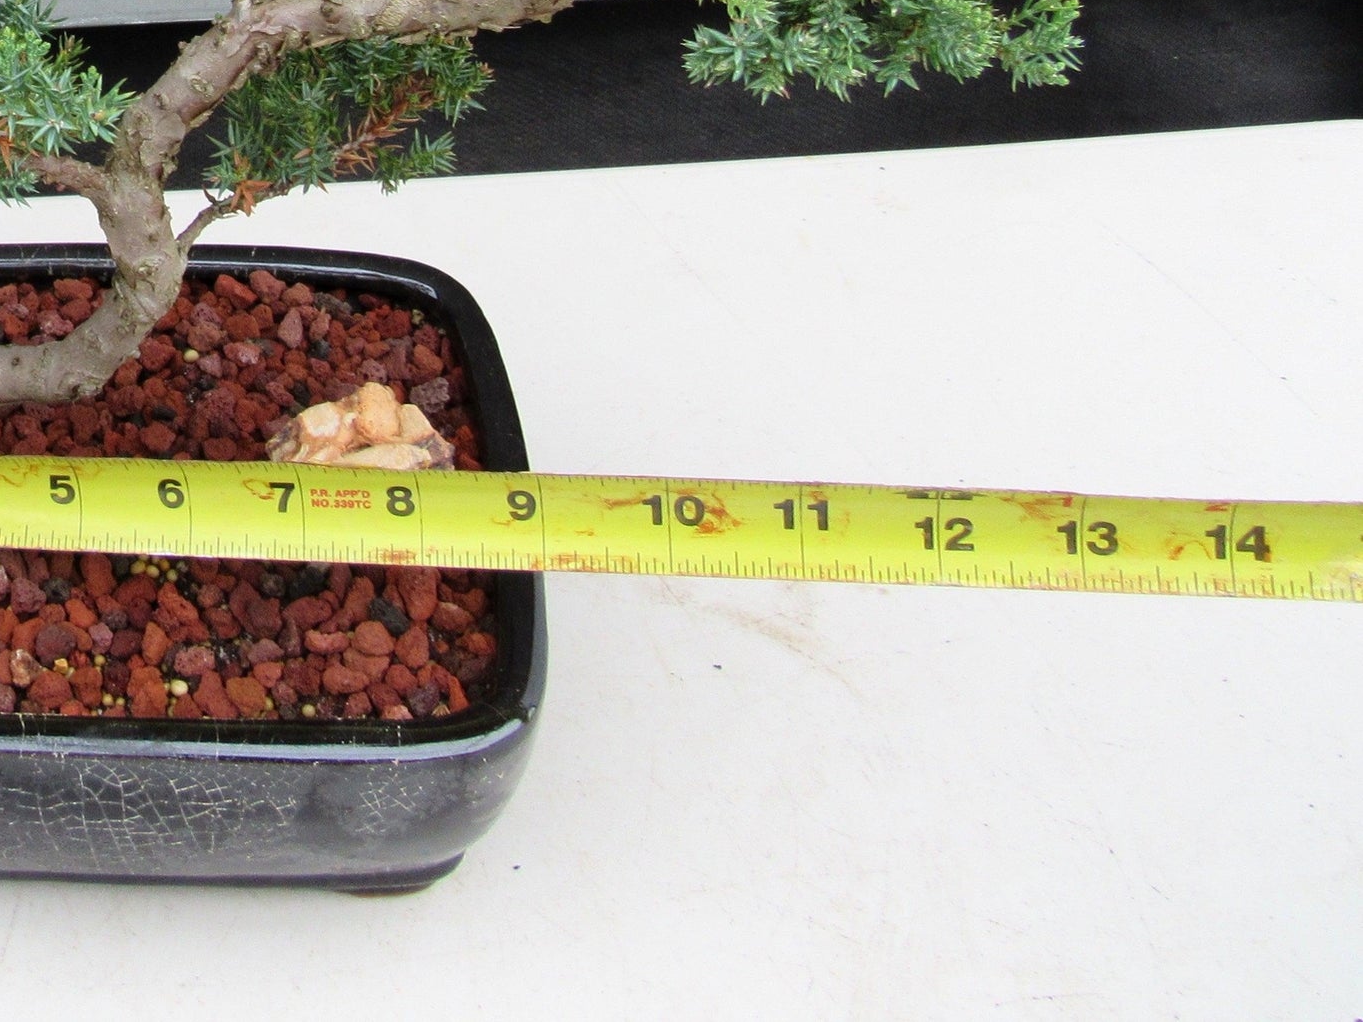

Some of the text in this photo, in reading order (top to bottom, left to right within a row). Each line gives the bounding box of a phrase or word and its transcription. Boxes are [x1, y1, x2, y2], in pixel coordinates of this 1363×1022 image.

[49, 474, 76, 505] 5
[157, 478, 185, 509] 6
[269, 482, 295, 513] 7
[386, 486, 415, 517] 8
[507, 490, 537, 521] 9
[642, 495, 705, 527] 10
[774, 499, 829, 531] 11
[915, 517, 975, 551] 12
[1057, 521, 1118, 555] 13
[1205, 525, 1271, 562] 14
